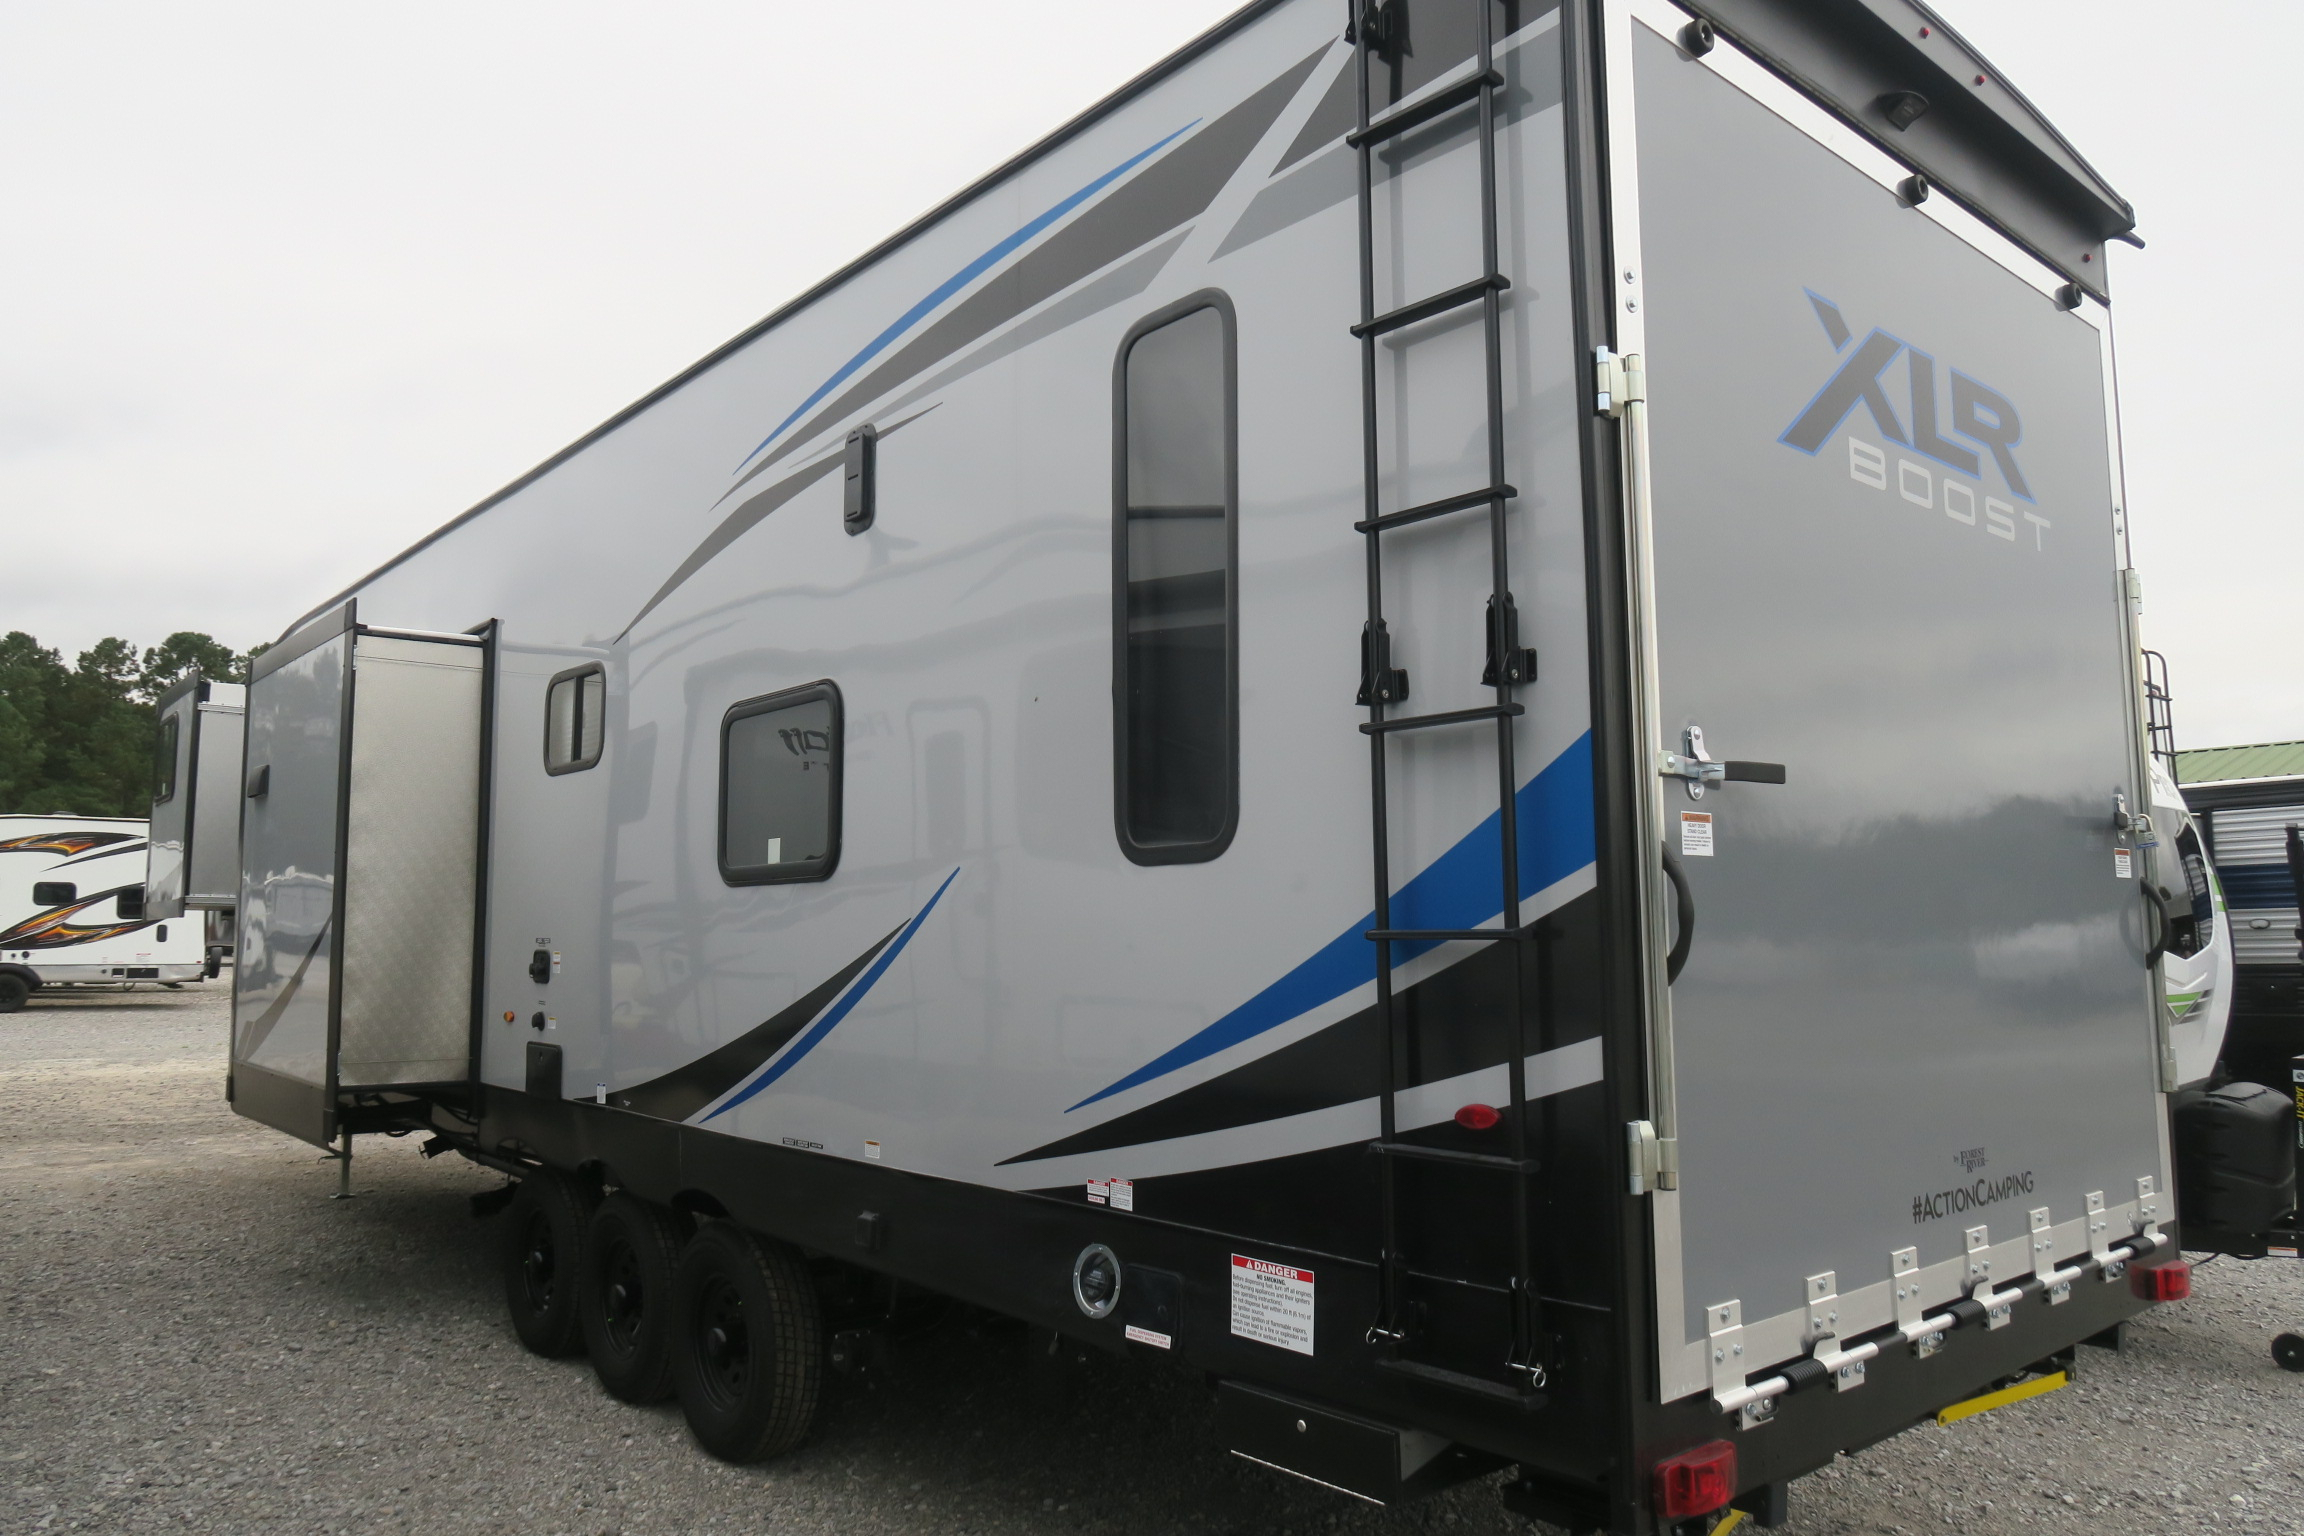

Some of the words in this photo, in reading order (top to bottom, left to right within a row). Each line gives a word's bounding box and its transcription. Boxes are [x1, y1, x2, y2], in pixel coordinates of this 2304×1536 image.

[1776, 286, 2038, 505] XLR
[1847, 436, 2051, 552] BOOST
[1255, 1262, 1297, 1279] DANGER
[1245, 1277, 1264, 1287] dispensing
[1255, 1287, 1275, 1297] appliances
[1271, 1320, 1291, 1331] flammable
[1280, 1330, 1299, 1340] explosion
